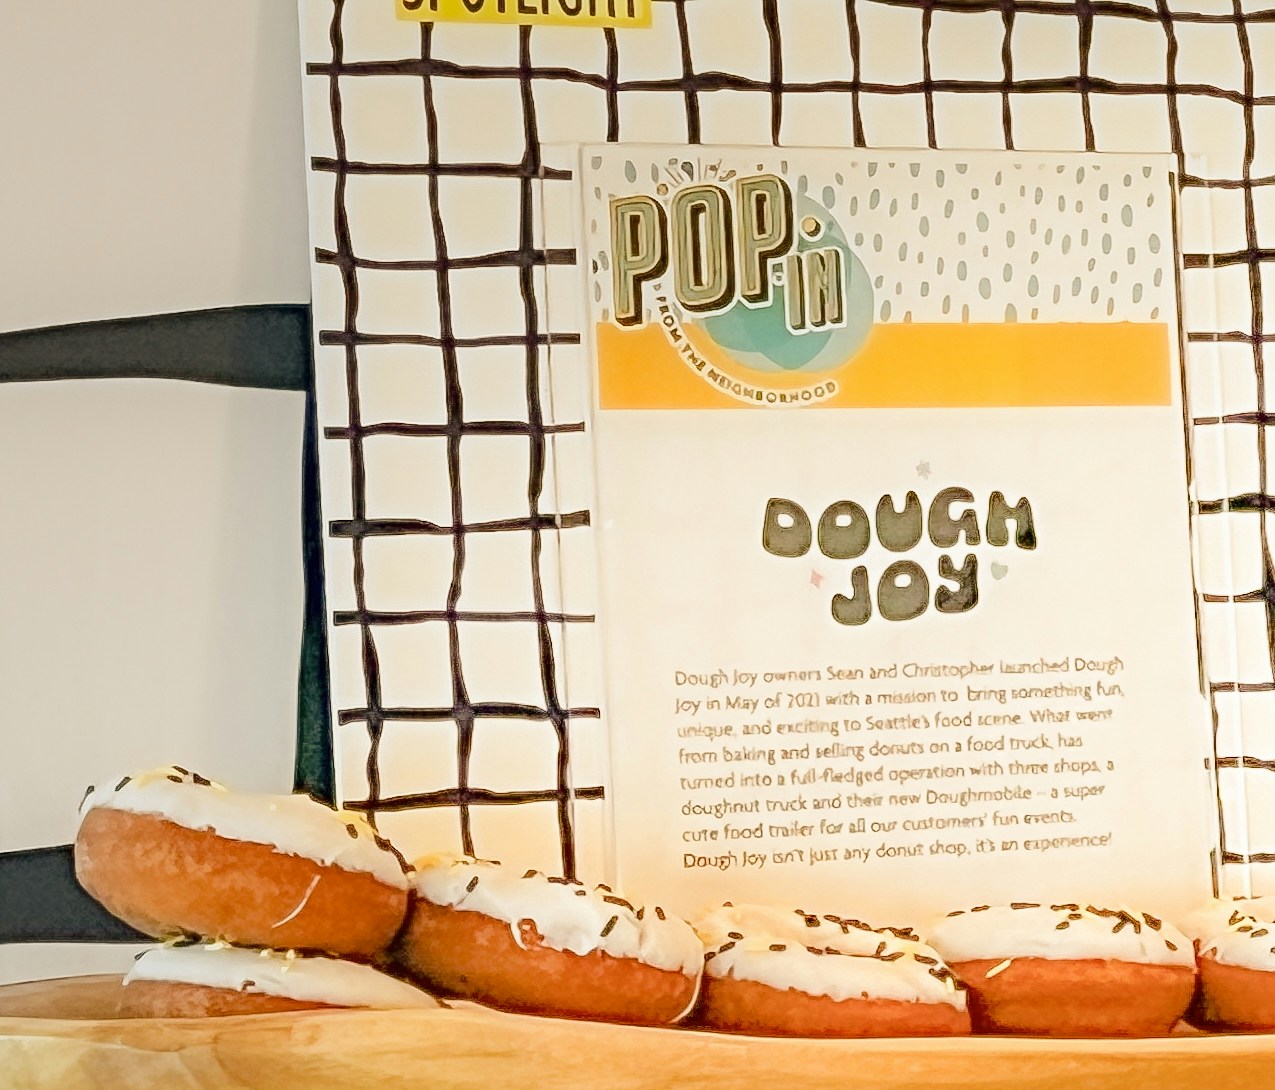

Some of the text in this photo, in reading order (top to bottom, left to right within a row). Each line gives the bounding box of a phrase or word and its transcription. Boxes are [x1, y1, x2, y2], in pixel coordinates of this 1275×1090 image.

[610, 174, 793, 326] POP
[786, 249, 844, 330] IN
[762, 486, 1037, 560] DOUGH
[831, 553, 978, 626] JOY
[675, 656, 1124, 688] Dough Joy owners Sean and Christopher launched Dough
[675, 698, 700, 715] Joy
[707, 699, 720, 710] in
[726, 696, 758, 714] May
[764, 692, 782, 708] of
[826, 691, 860, 705] with
[865, 694, 872, 704] a
[877, 690, 936, 704] mission
[941, 690, 958, 701] to
[967, 686, 1006, 704] bring
[1011, 682, 1091, 700] something
[742, 720, 771, 735] and
[777, 720, 839, 736] exciting
[844, 719, 861, 731] to
[935, 711, 972, 728] food
[1030, 709, 1069, 722] What
[1076, 709, 1112, 721] went
[679, 749, 717, 763] from
[723, 746, 775, 765] baking
[781, 744, 809, 759] and
[816, 743, 864, 761] selling
[869, 741, 924, 755] donuts
[929, 741, 949, 753] on
[955, 742, 961, 752] a
[967, 735, 1004, 751] food
[1058, 733, 1083, 748] has
[680, 772, 735, 790] turned
[740, 773, 772, 786] into
[778, 775, 784, 785] a
[791, 767, 883, 786] full-fledged
[889, 765, 965, 785] operation
[970, 761, 1003, 775] with
[1009, 760, 1048, 774] three
[1107, 760, 1114, 770] a
[681, 794, 760, 818] doughnut
[766, 794, 806, 810] truck
[813, 794, 841, 809] and
[847, 794, 883, 808] their
[889, 792, 921, 805] new
[927, 786, 1031, 807] Doughmobile
[1051, 787, 1058, 798] a
[1064, 785, 1105, 800] super
[682, 828, 718, 842] cute
[724, 823, 763, 840] food
[769, 821, 814, 837] trailer
[820, 819, 843, 834] for
[849, 818, 865, 833] all
[871, 821, 898, 832] our
[993, 810, 1019, 826] fun
[683, 851, 737, 870] Dough
[742, 851, 767, 868] Joy
[773, 849, 804, 863] isn't
[810, 847, 839, 865] just
[844, 847, 871, 863] any
[876, 843, 924, 857] donut
[976, 839, 995, 853] it's
[1002, 840, 1018, 850] an
